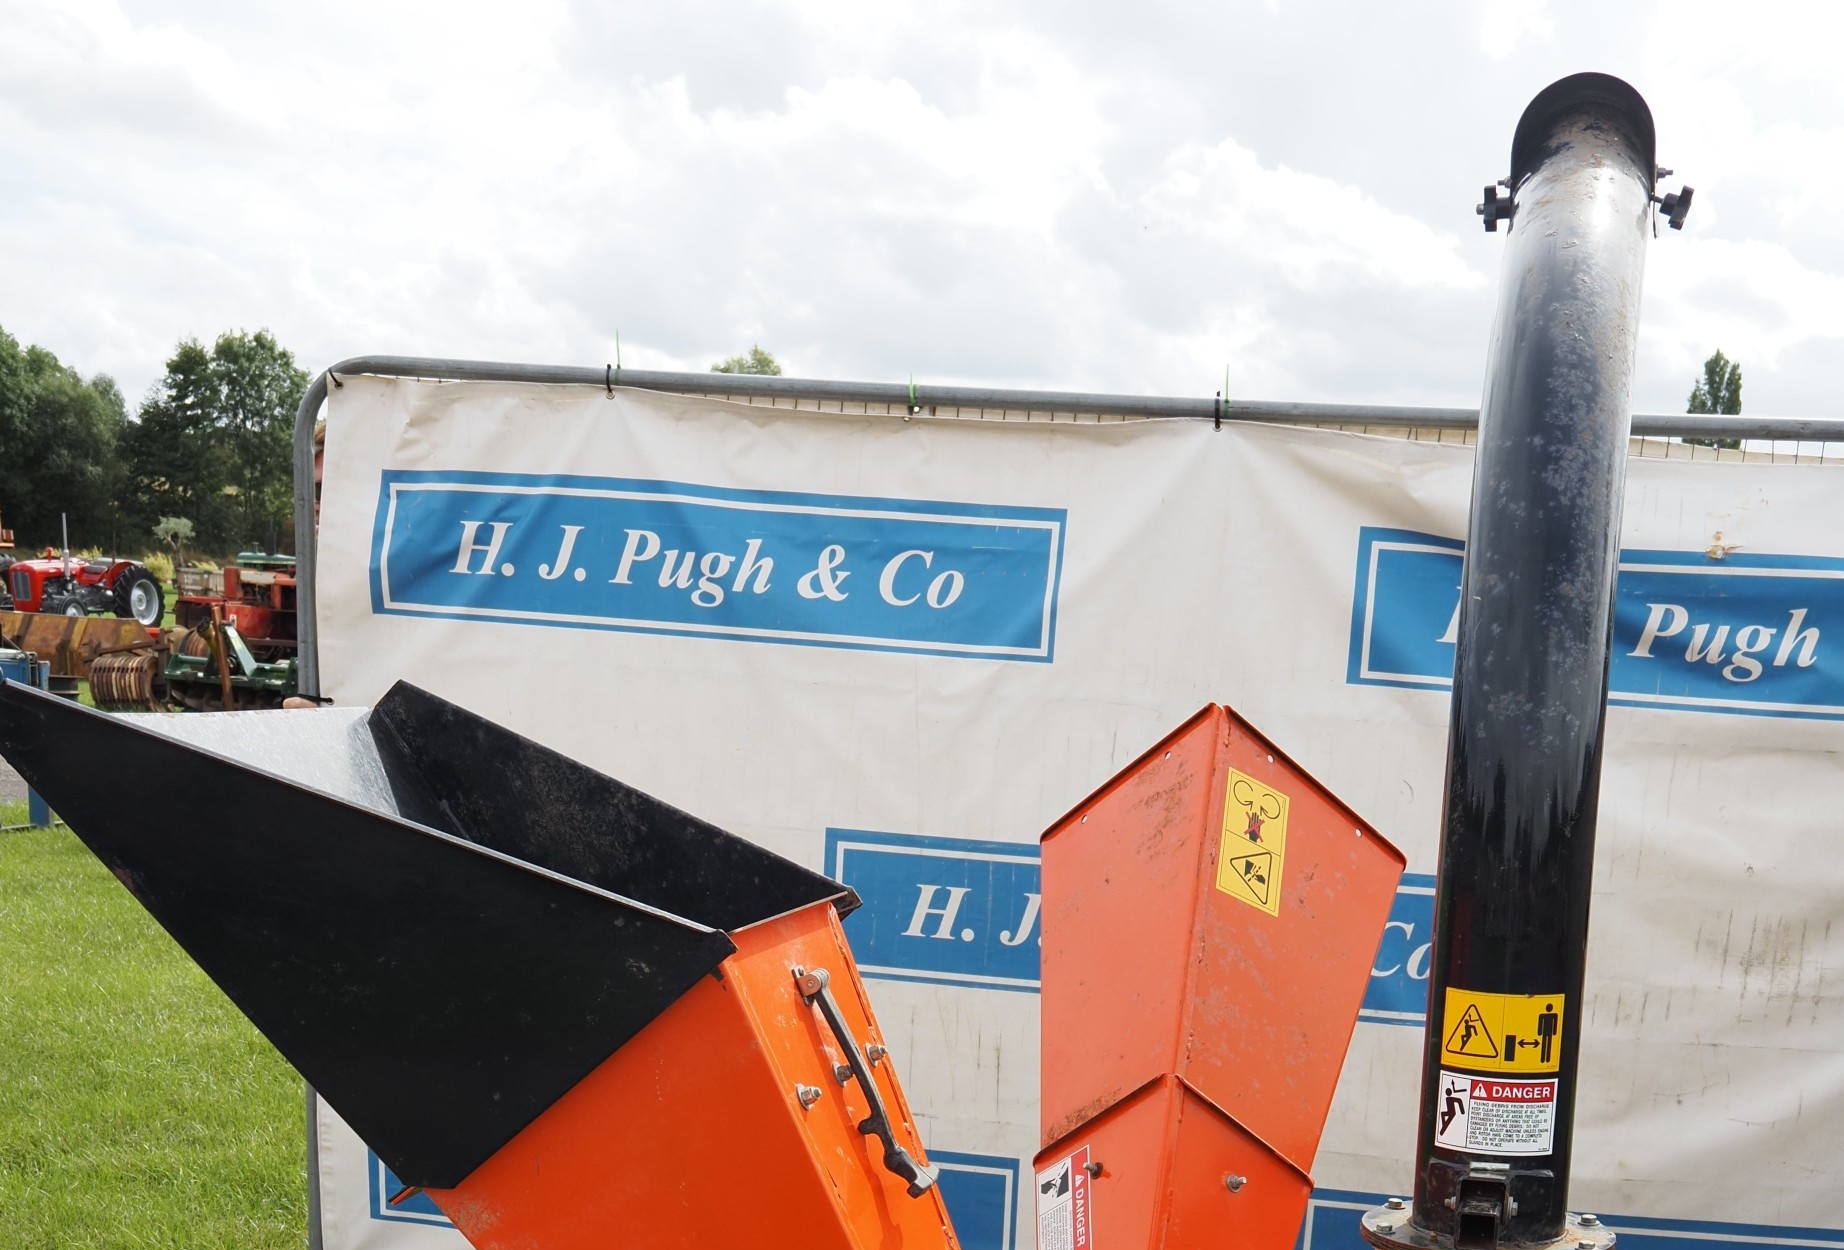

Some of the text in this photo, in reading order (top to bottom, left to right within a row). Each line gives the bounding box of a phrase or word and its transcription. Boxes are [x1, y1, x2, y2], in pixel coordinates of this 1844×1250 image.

[448, 520, 965, 609] H. J. Pugh & Co
[1626, 602, 1823, 683] Pugh
[900, 884, 1041, 946] H. J
[1371, 921, 1432, 980] Co
[1492, 1087, 1550, 1098] DANGER
[1075, 1188, 1086, 1247] DANGER
